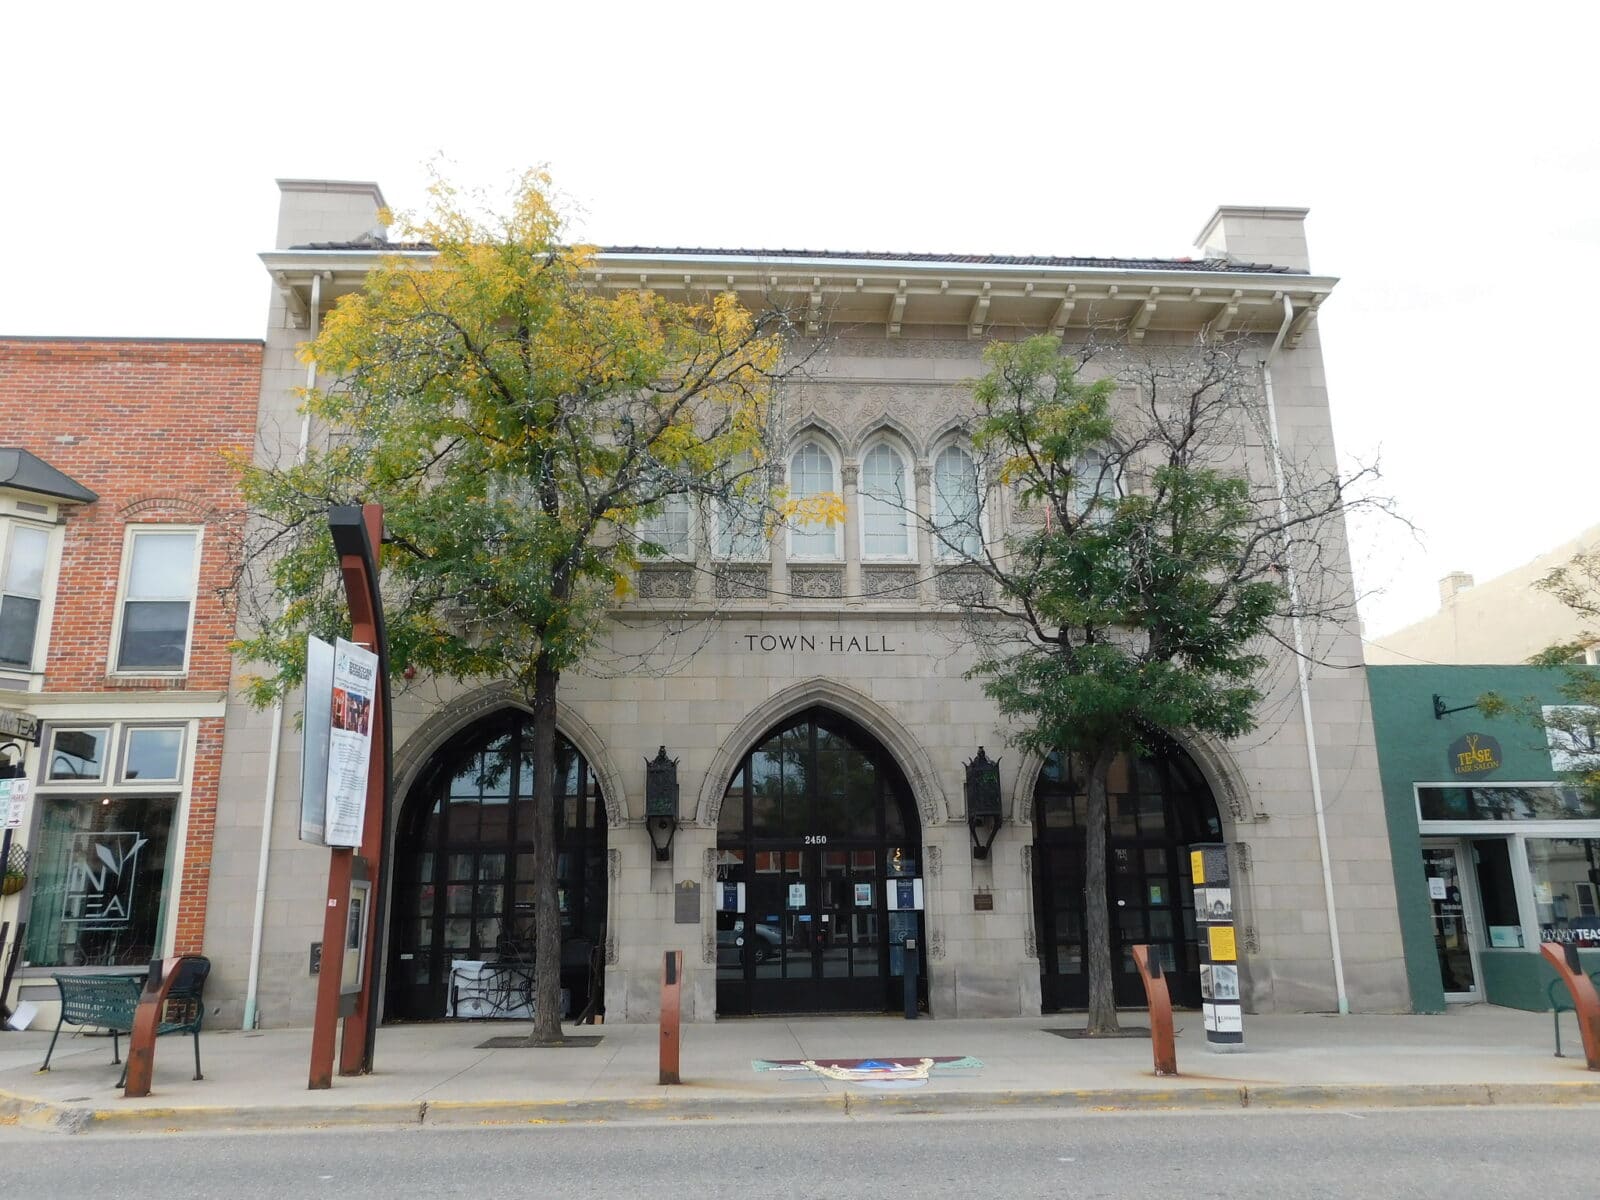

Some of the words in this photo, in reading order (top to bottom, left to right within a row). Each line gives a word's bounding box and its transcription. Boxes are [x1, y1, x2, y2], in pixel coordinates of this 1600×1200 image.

[744, 635, 815, 651] TOWN
[830, 635, 896, 652] HALL
[16, 717, 36, 737] TEA
[1457, 748, 1492, 766] TEASE
[1455, 764, 1473, 774] HAIR
[1473, 760, 1499, 771] SALON
[805, 835, 827, 845] 2450
[68, 894, 126, 918] TEA
